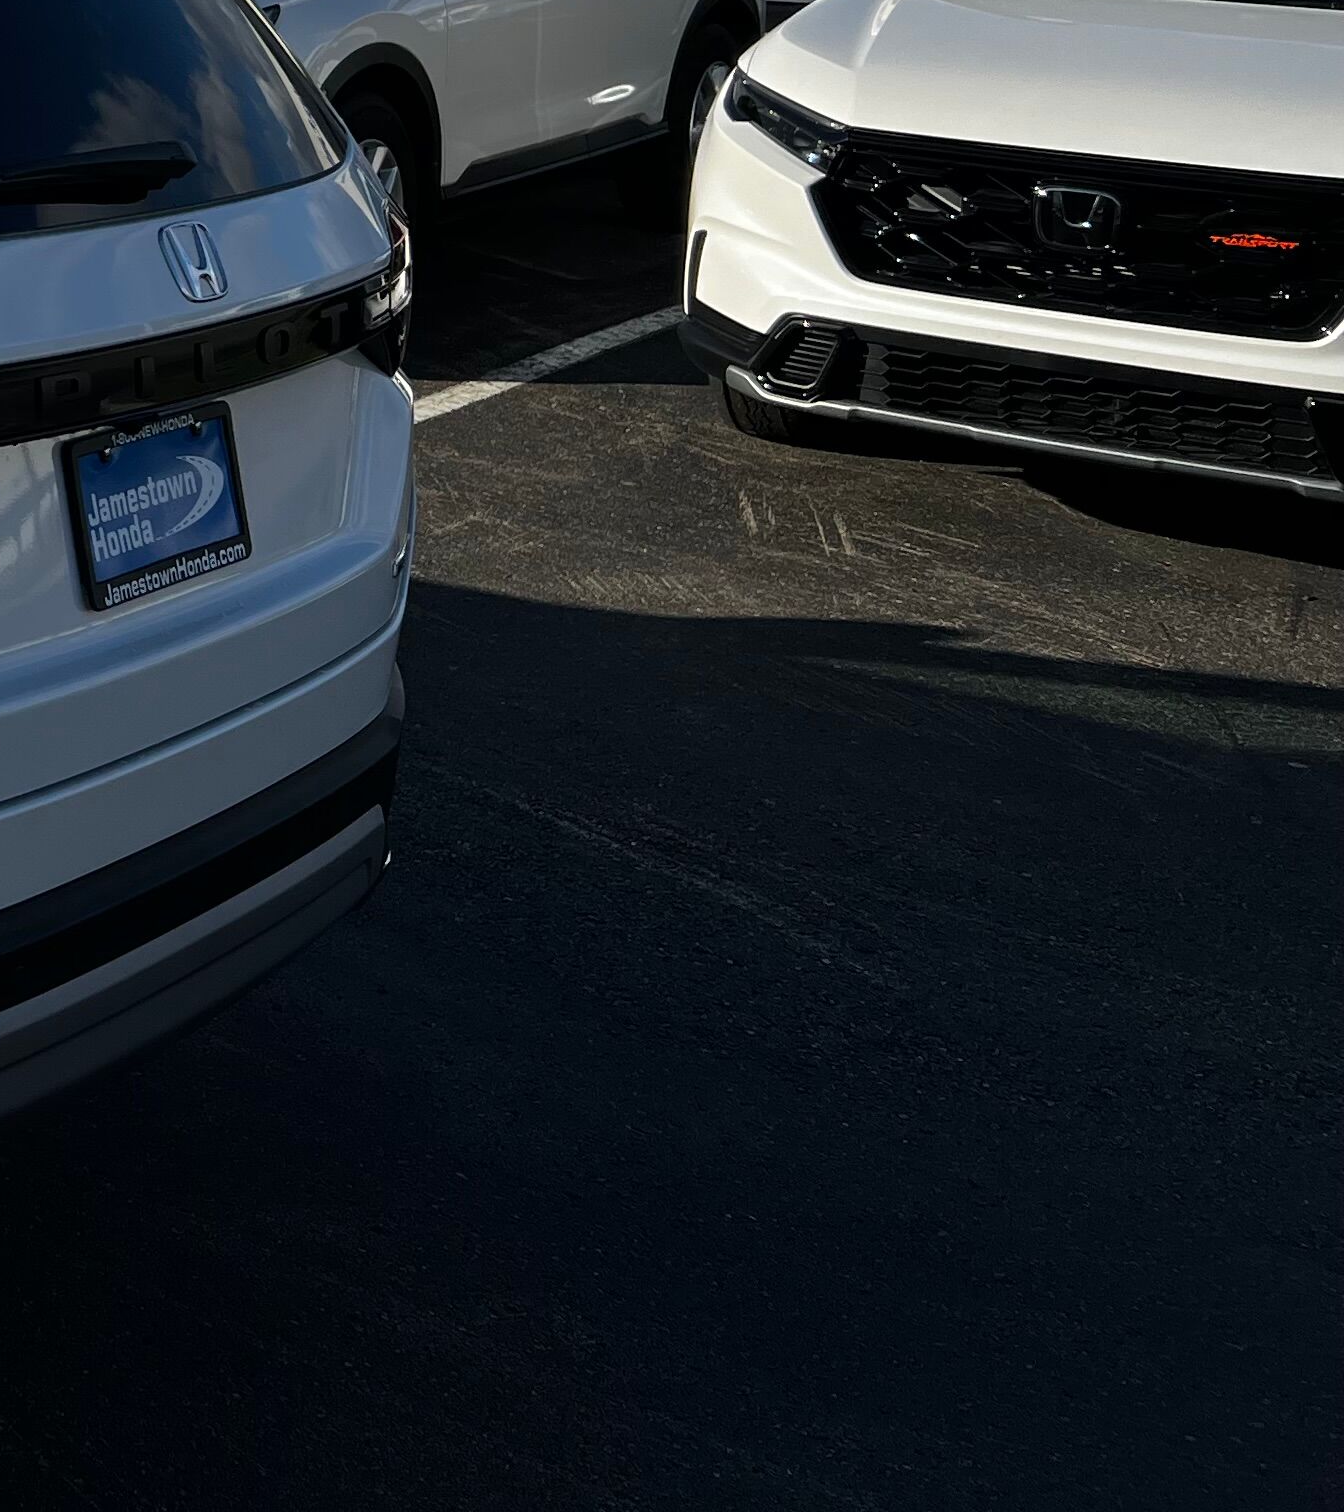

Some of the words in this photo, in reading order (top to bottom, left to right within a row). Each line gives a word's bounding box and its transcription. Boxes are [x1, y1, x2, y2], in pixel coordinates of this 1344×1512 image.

[1209, 235, 1300, 250] TRAILSPORT
[88, 471, 198, 526] Jamestown
[90, 514, 155, 563] Honda
[104, 542, 247, 607] JamestownHonda.com
